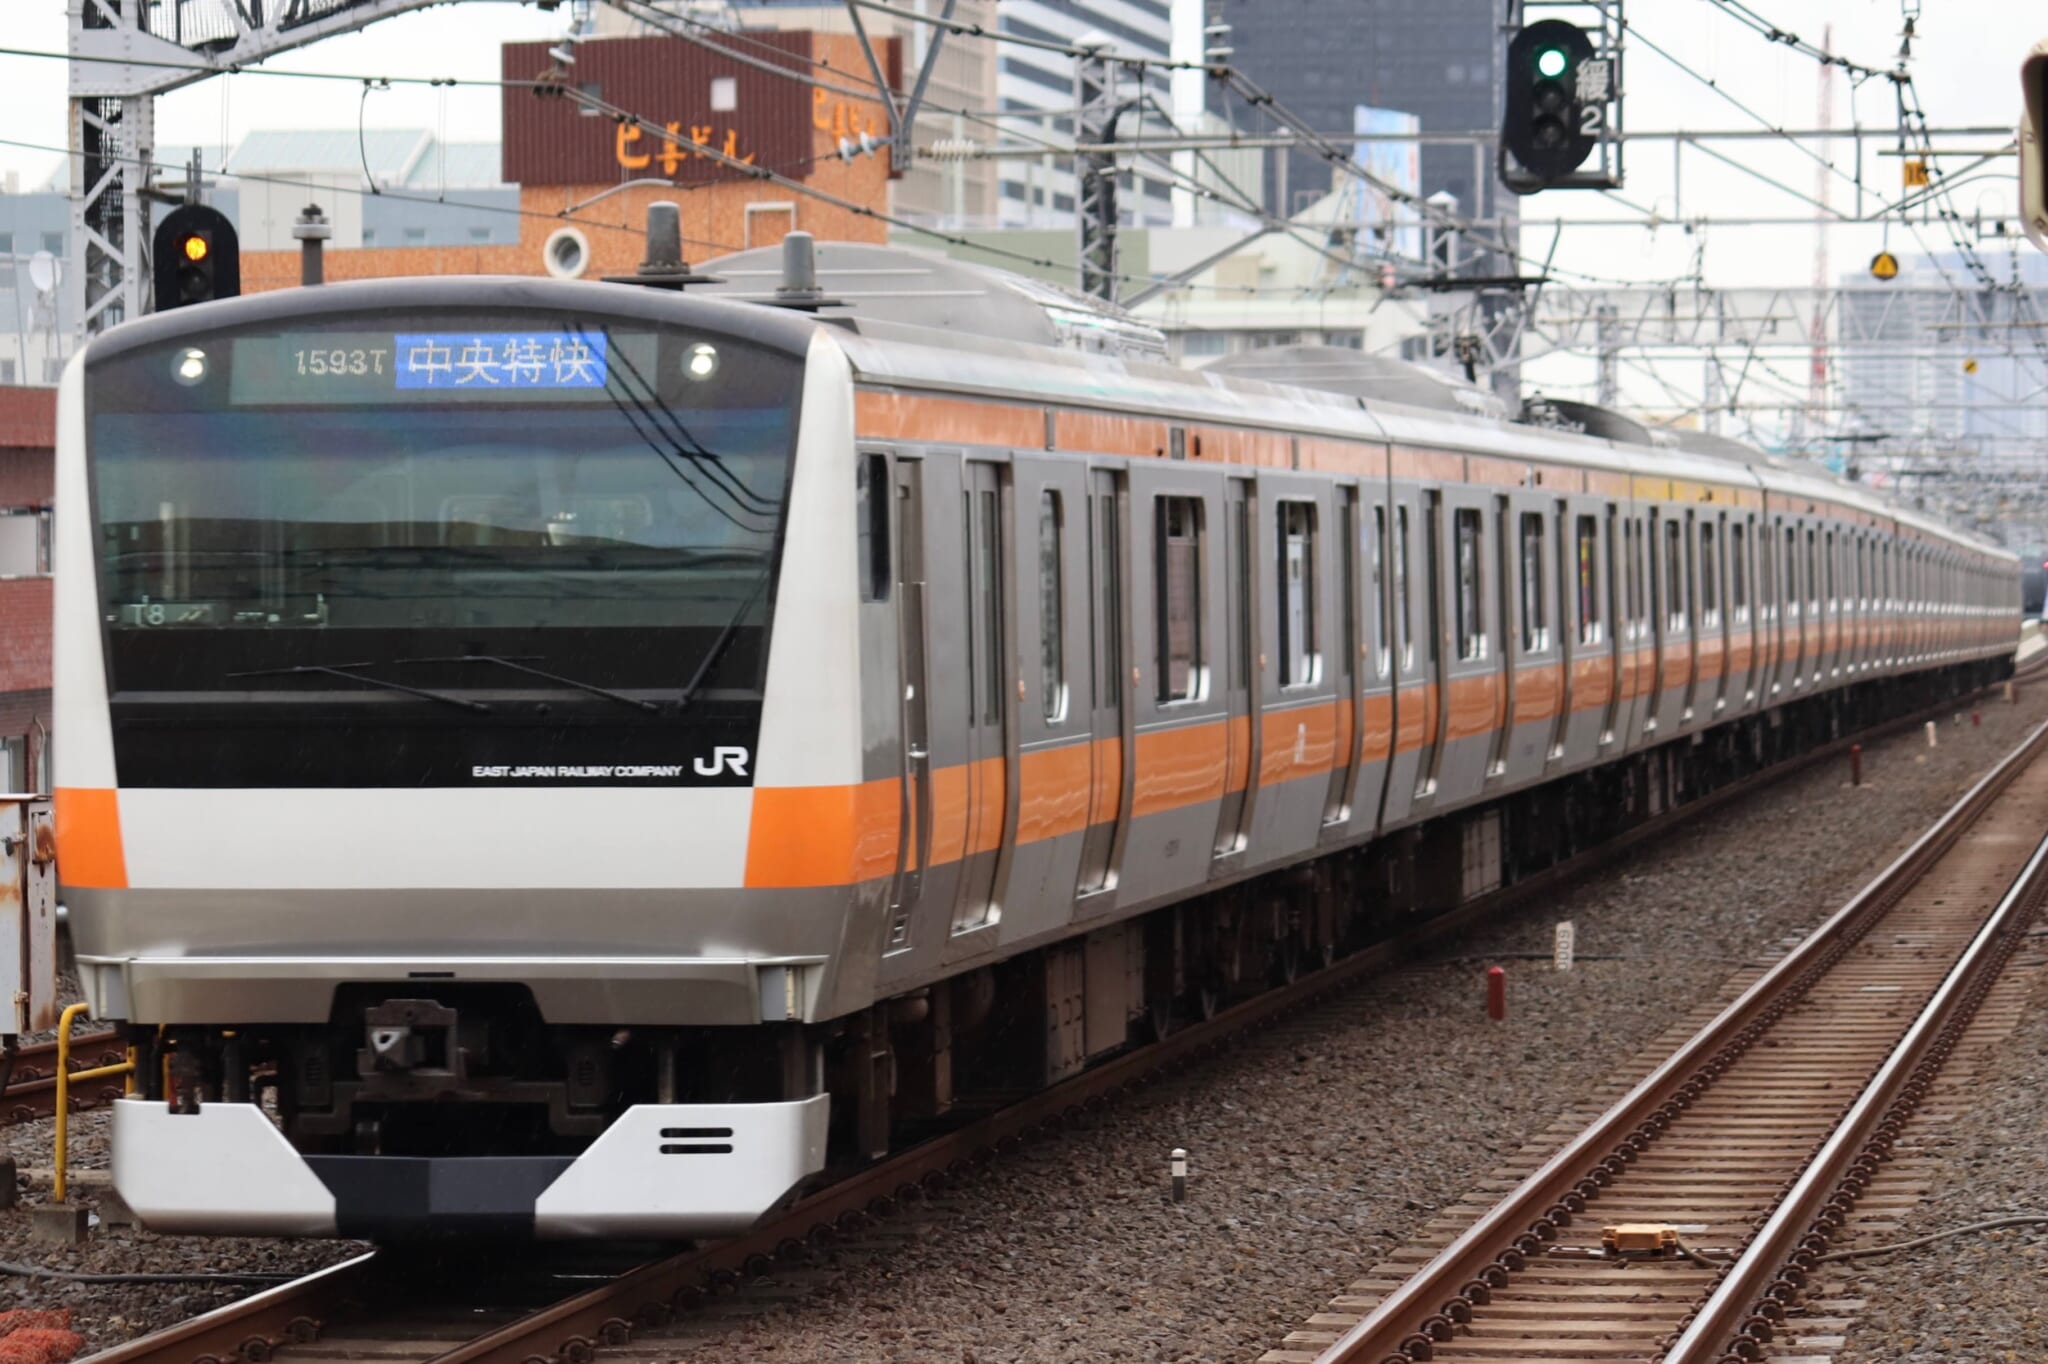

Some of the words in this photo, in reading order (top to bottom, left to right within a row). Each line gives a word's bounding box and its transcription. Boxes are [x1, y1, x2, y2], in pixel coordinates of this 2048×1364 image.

[295, 350, 387, 375] 1593T
[409, 338, 594, 384] 中央特快
[472, 766, 511, 777] EAST
[510, 766, 556, 777] JAPAN
[558, 766, 614, 777] RAILWAY
[614, 766, 683, 777] COMPANY
[694, 746, 749, 776] JR
